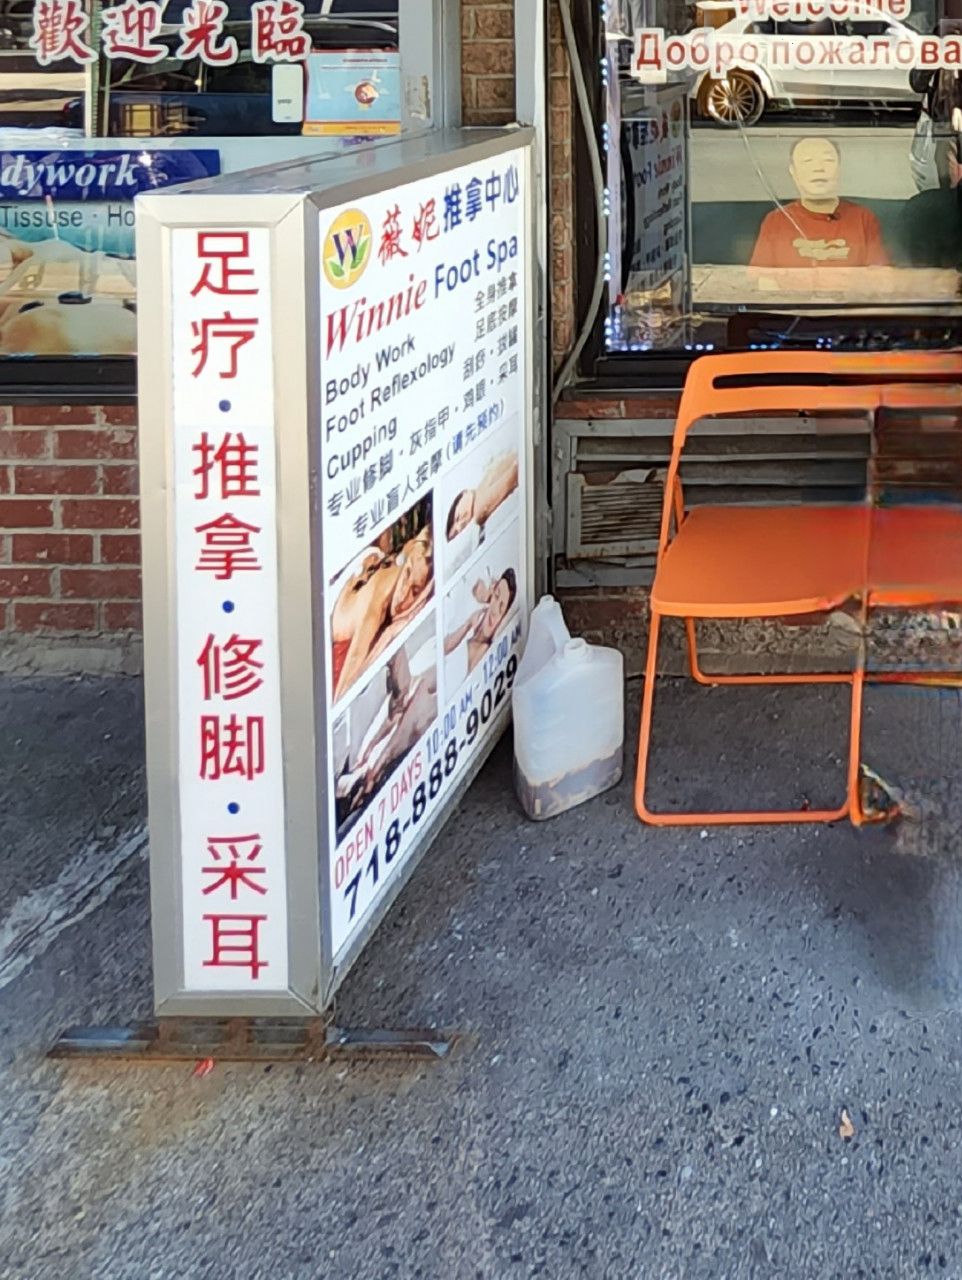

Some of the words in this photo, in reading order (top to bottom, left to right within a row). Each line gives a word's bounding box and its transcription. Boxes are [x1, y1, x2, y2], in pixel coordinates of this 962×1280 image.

[35, 0, 310, 61] 歡迎光臨
[636, 32, 759, 74] Добро
[0, 154, 139, 195] dywork
[0, 205, 83, 228] Tissuse
[326, 273, 428, 361] Winnie
[434, 249, 480, 299] Foot
[487, 235, 518, 271] Spa
[325, 361, 371, 406] Body
[375, 333, 416, 373] Work
[325, 398, 365, 443] Foot
[370, 341, 456, 412] Reflexology
[327, 417, 398, 480] Cupping
[335, 821, 374, 891] OPEN
[378, 797, 387, 831] 7
[390, 750, 423, 815] DAYS
[343, 653, 519, 924] 718-888-9029
